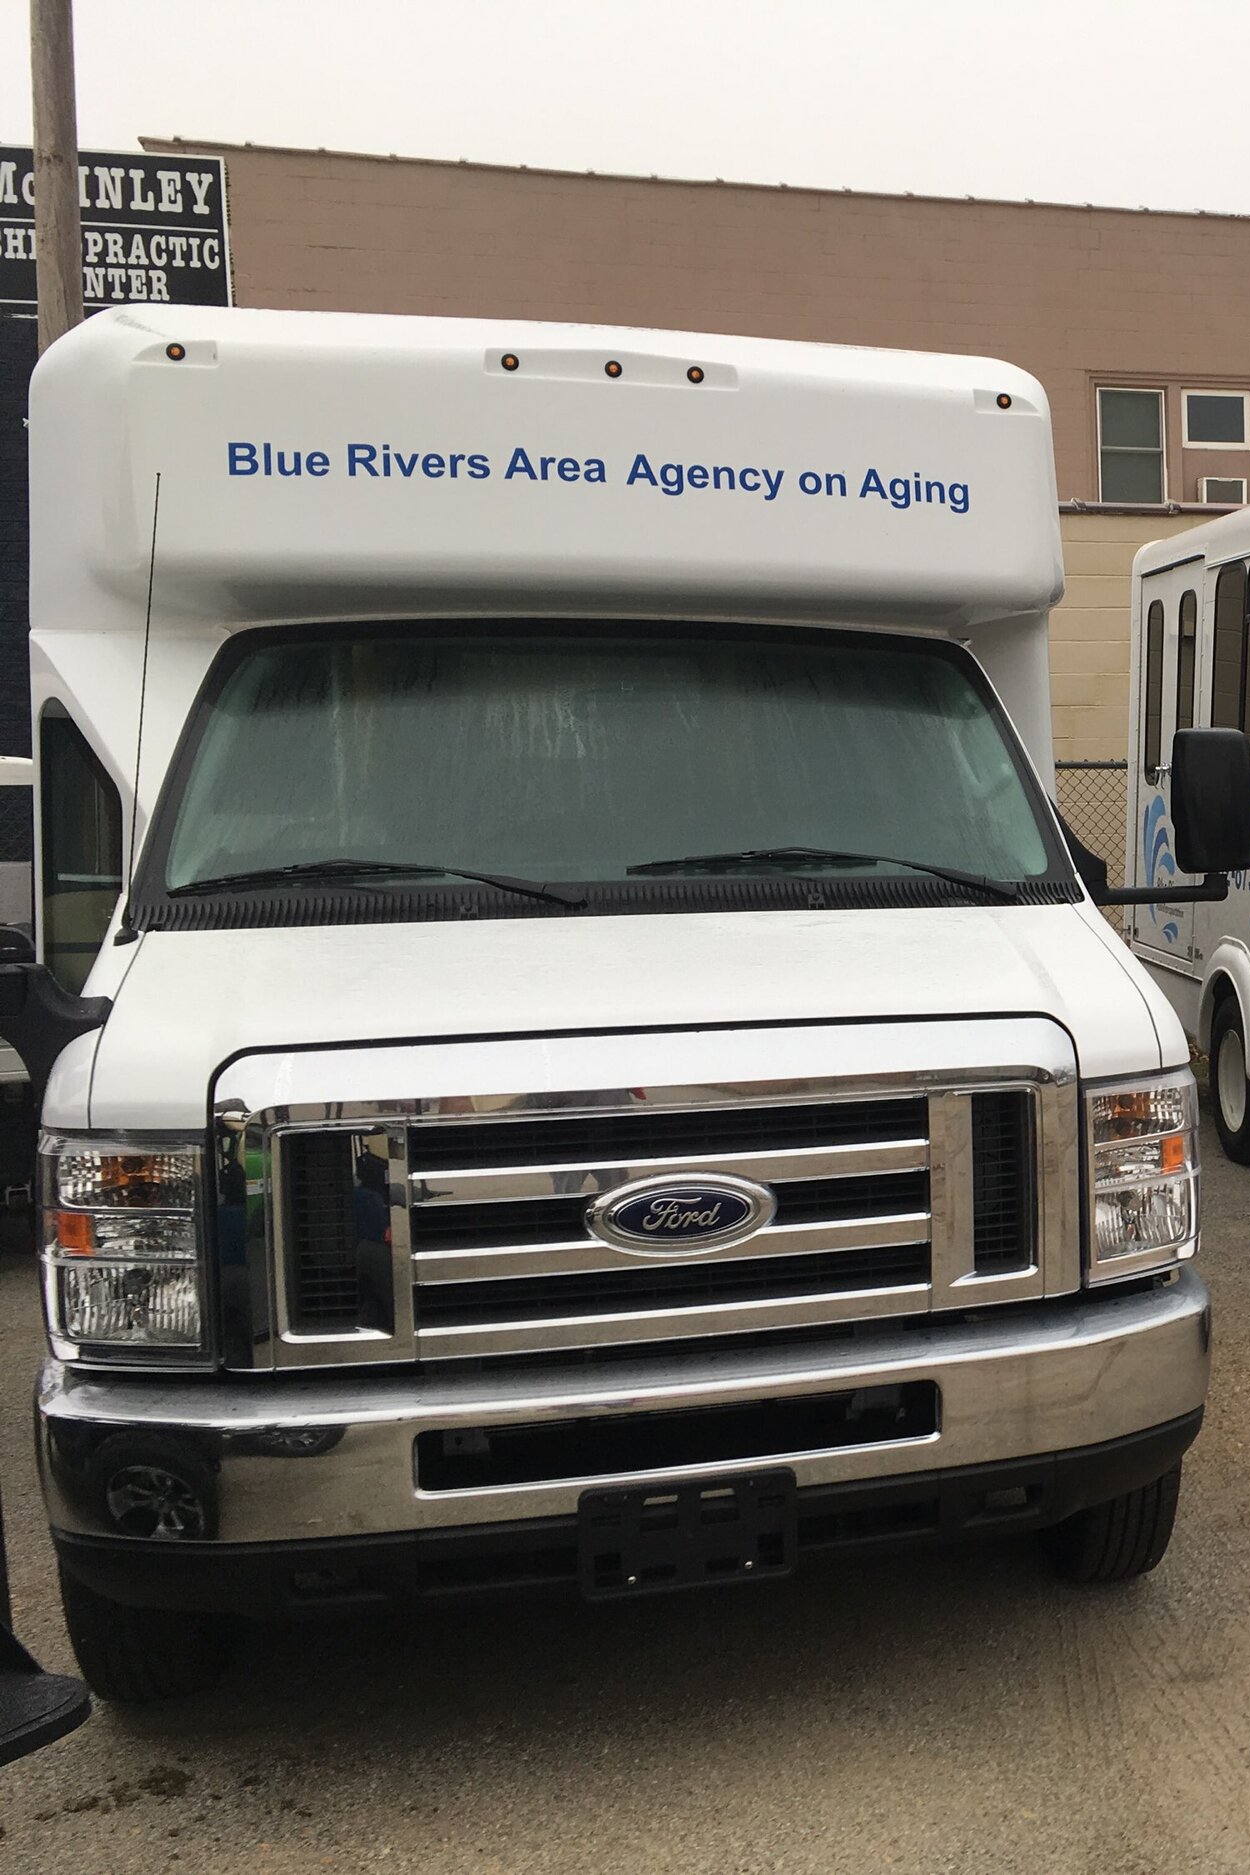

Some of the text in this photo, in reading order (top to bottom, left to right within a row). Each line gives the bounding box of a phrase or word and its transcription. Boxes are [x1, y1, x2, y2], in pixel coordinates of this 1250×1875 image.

[0, 161, 213, 214] McINLEY
[0, 228, 220, 270] HIPRACTIC
[83, 267, 170, 301] NTER
[227, 442, 970, 514] Blue Rivers Area Agency on Aging
[642, 1197, 722, 1231] Ford
